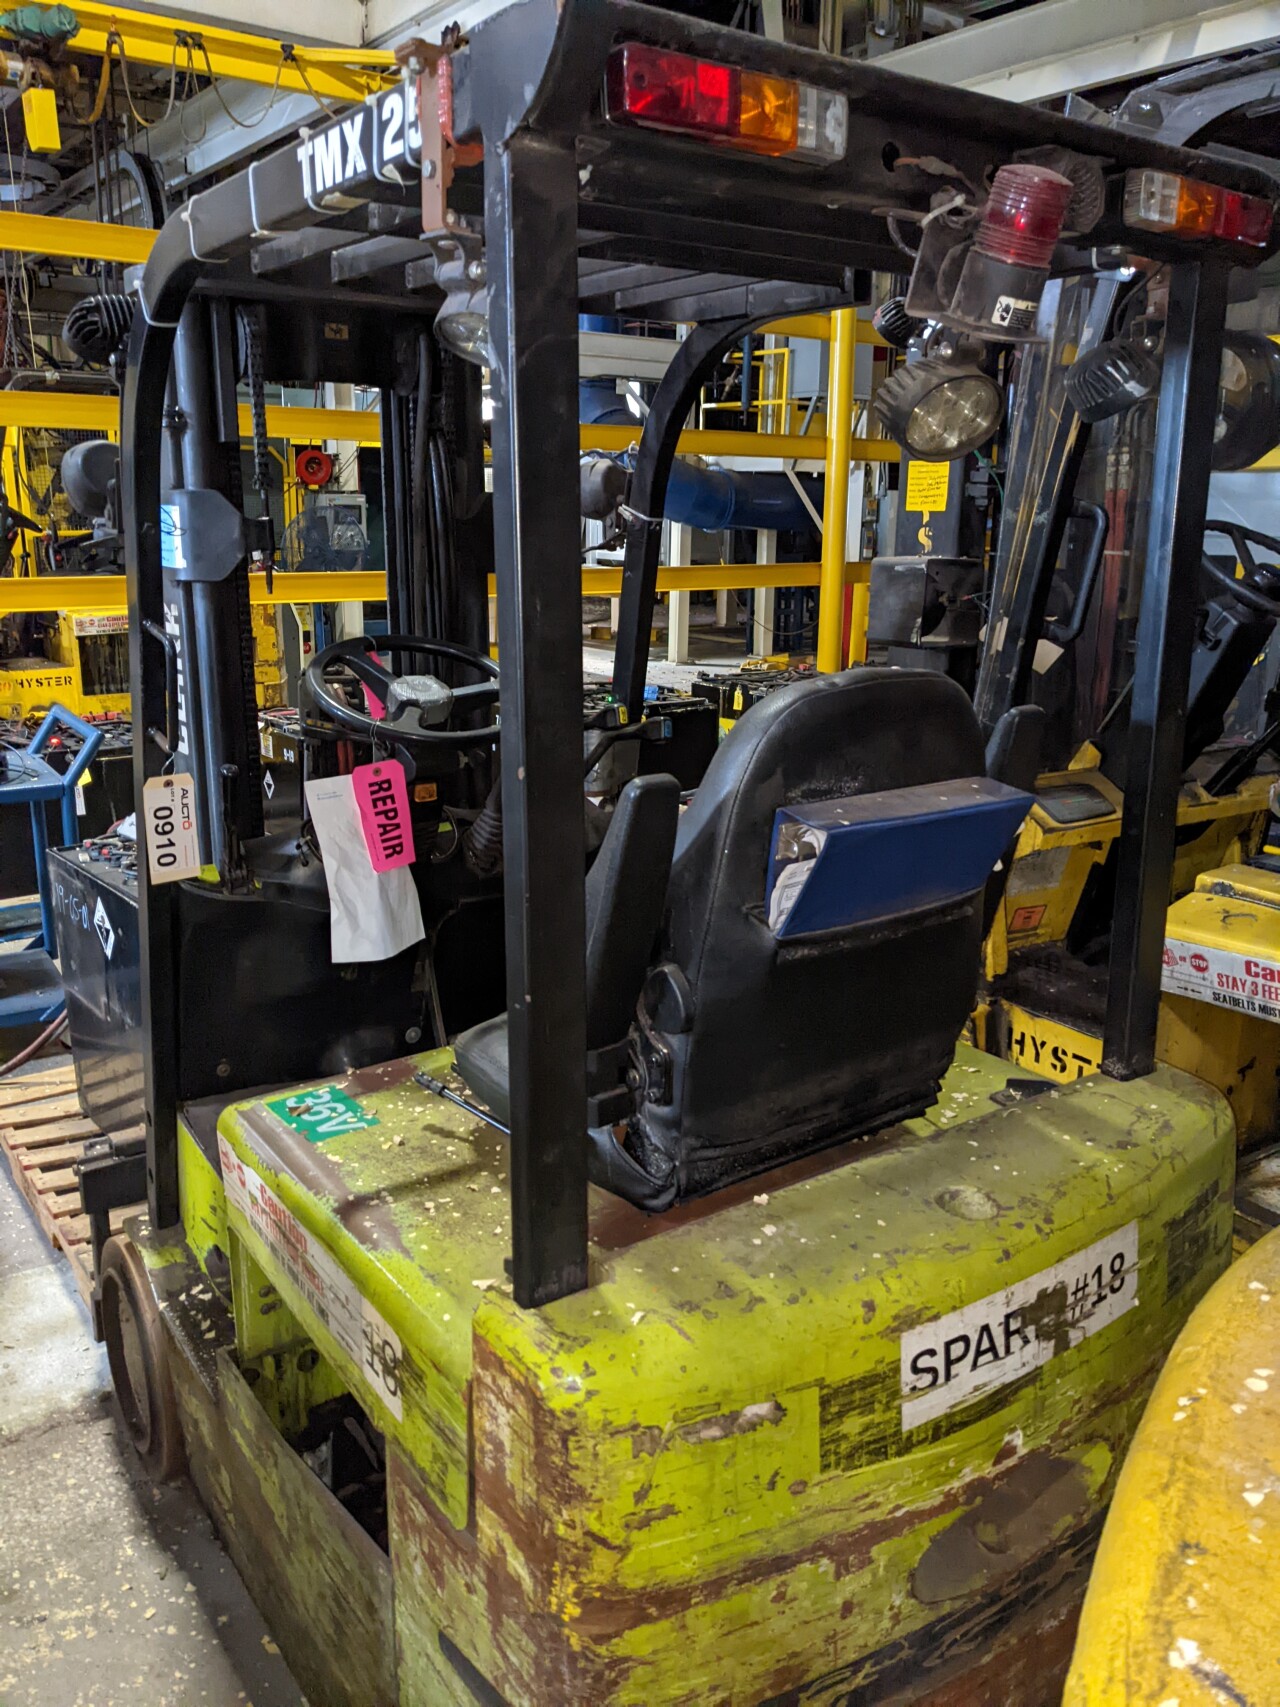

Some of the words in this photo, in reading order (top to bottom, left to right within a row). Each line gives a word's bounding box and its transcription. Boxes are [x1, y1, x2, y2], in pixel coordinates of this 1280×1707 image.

[297, 112, 367, 199] TMX
[15, 675, 73, 688] HYSTER
[153, 806, 177, 867] 0910
[368, 778, 404, 860] REPAIR
[1191, 958, 1207, 968] STOP
[1216, 972, 1247, 993] STAY
[1250, 981, 1259, 997] 3
[1212, 991, 1256, 1012] SEATBELTS
[1007, 1026, 1101, 1079] HYST
[286, 1088, 368, 1133] 36V
[909, 1310, 1040, 1391] SPAR
[1070, 1252, 1126, 1320] #18
